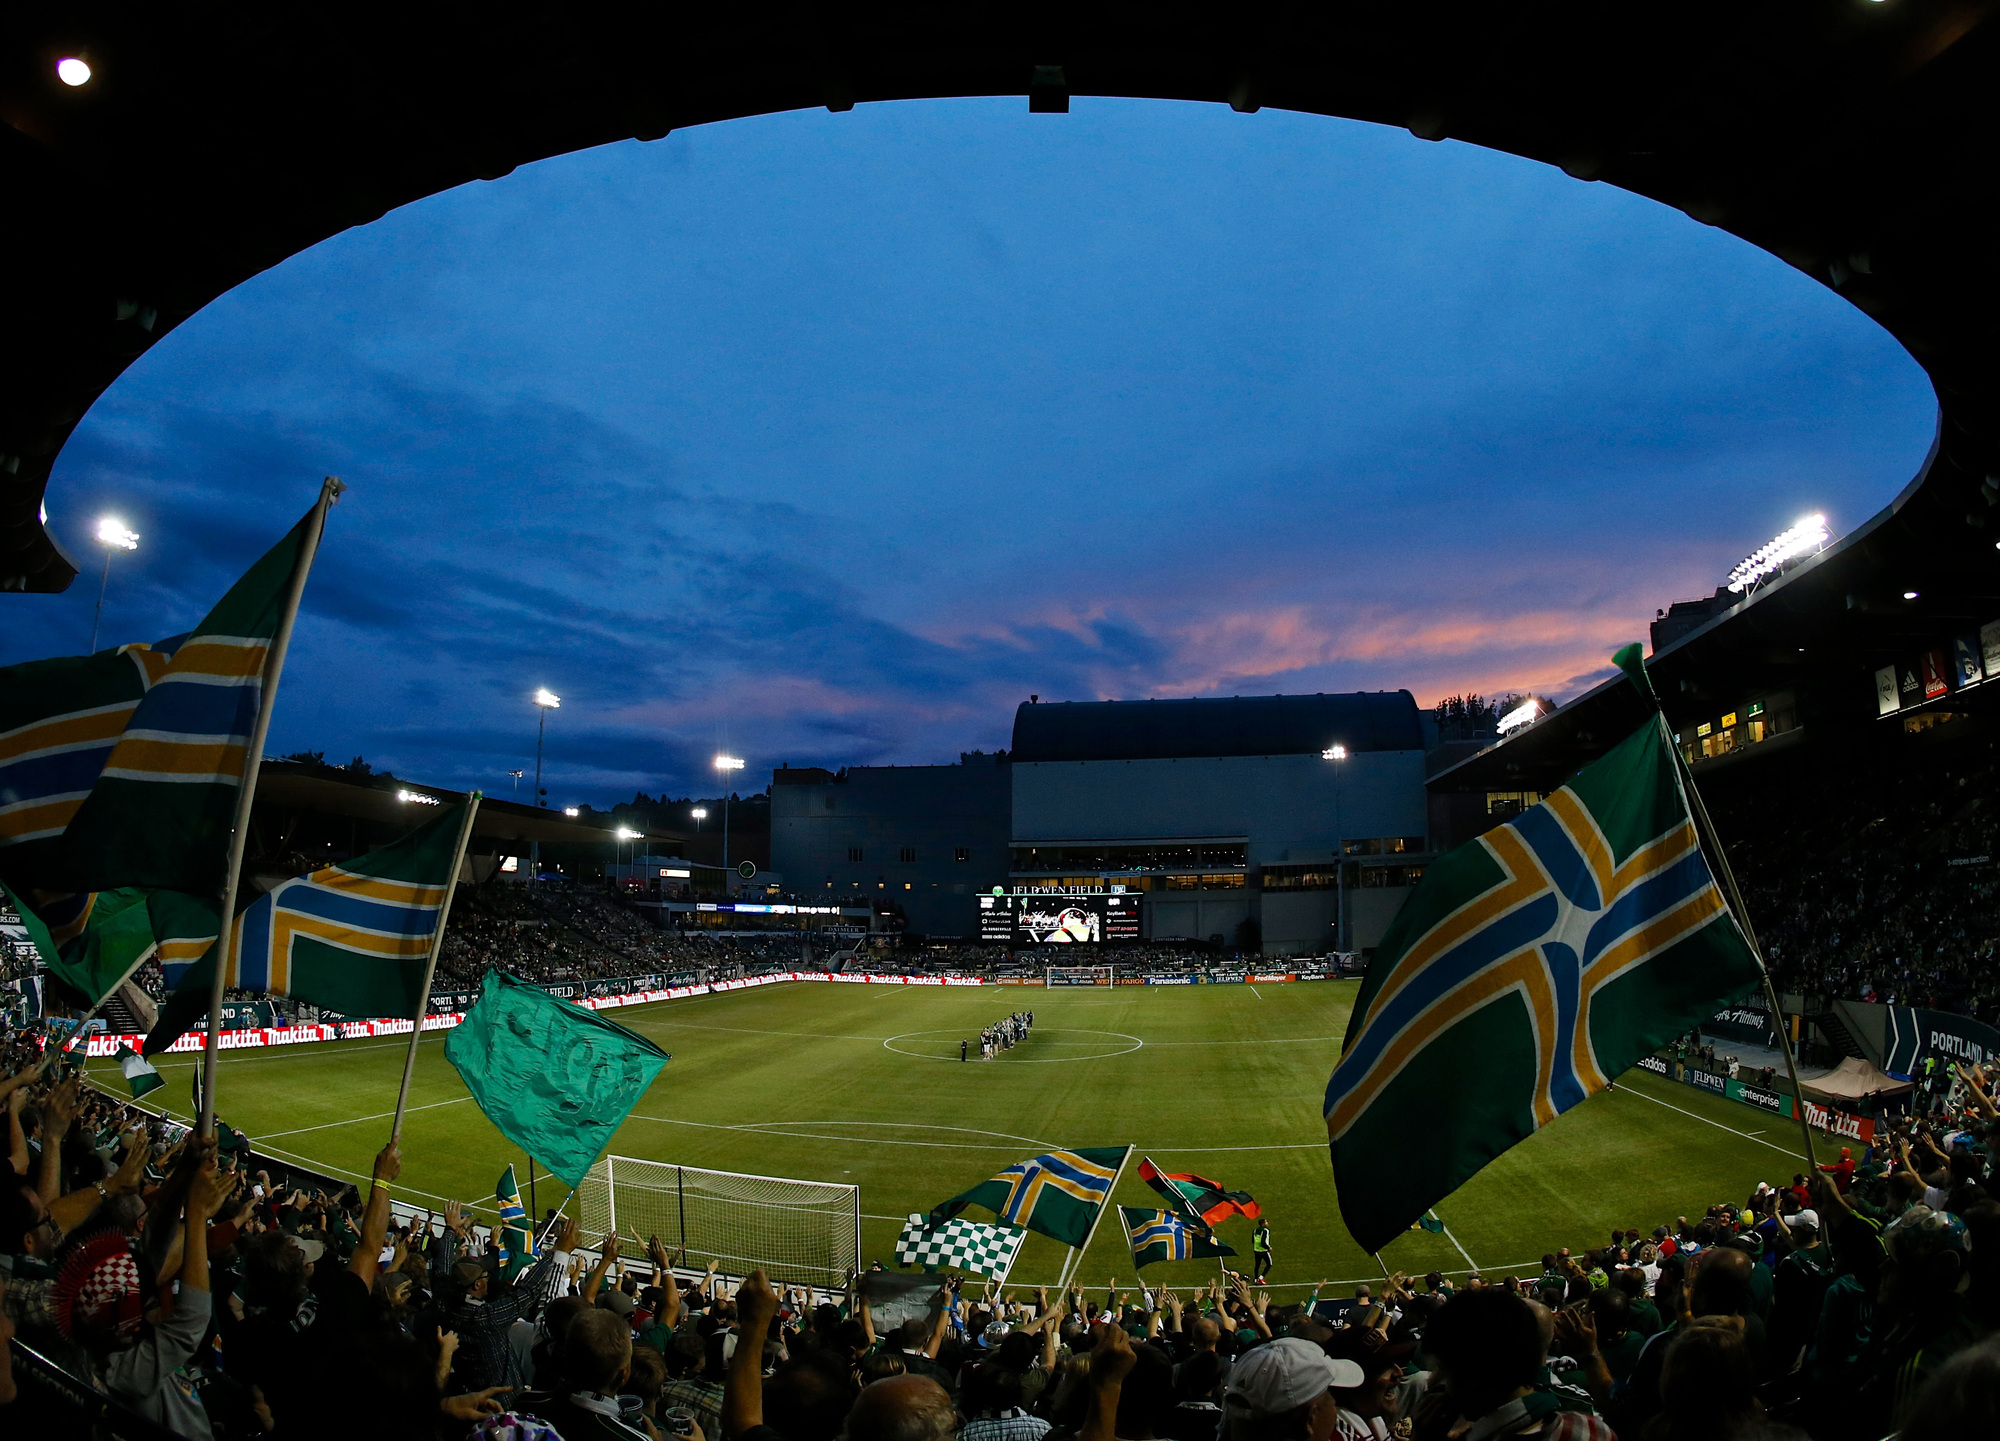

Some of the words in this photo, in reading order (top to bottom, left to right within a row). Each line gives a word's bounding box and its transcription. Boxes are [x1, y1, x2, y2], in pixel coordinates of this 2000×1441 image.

[1070, 886, 1103, 895] FIELD
[1150, 976, 1191, 985] Panasonic
[1731, 1010, 1765, 1029] Airlines
[1930, 1030, 1983, 1065] PORTLAND
[1644, 1057, 1667, 1074] adidas
[1738, 1087, 1780, 1108] enterprise
